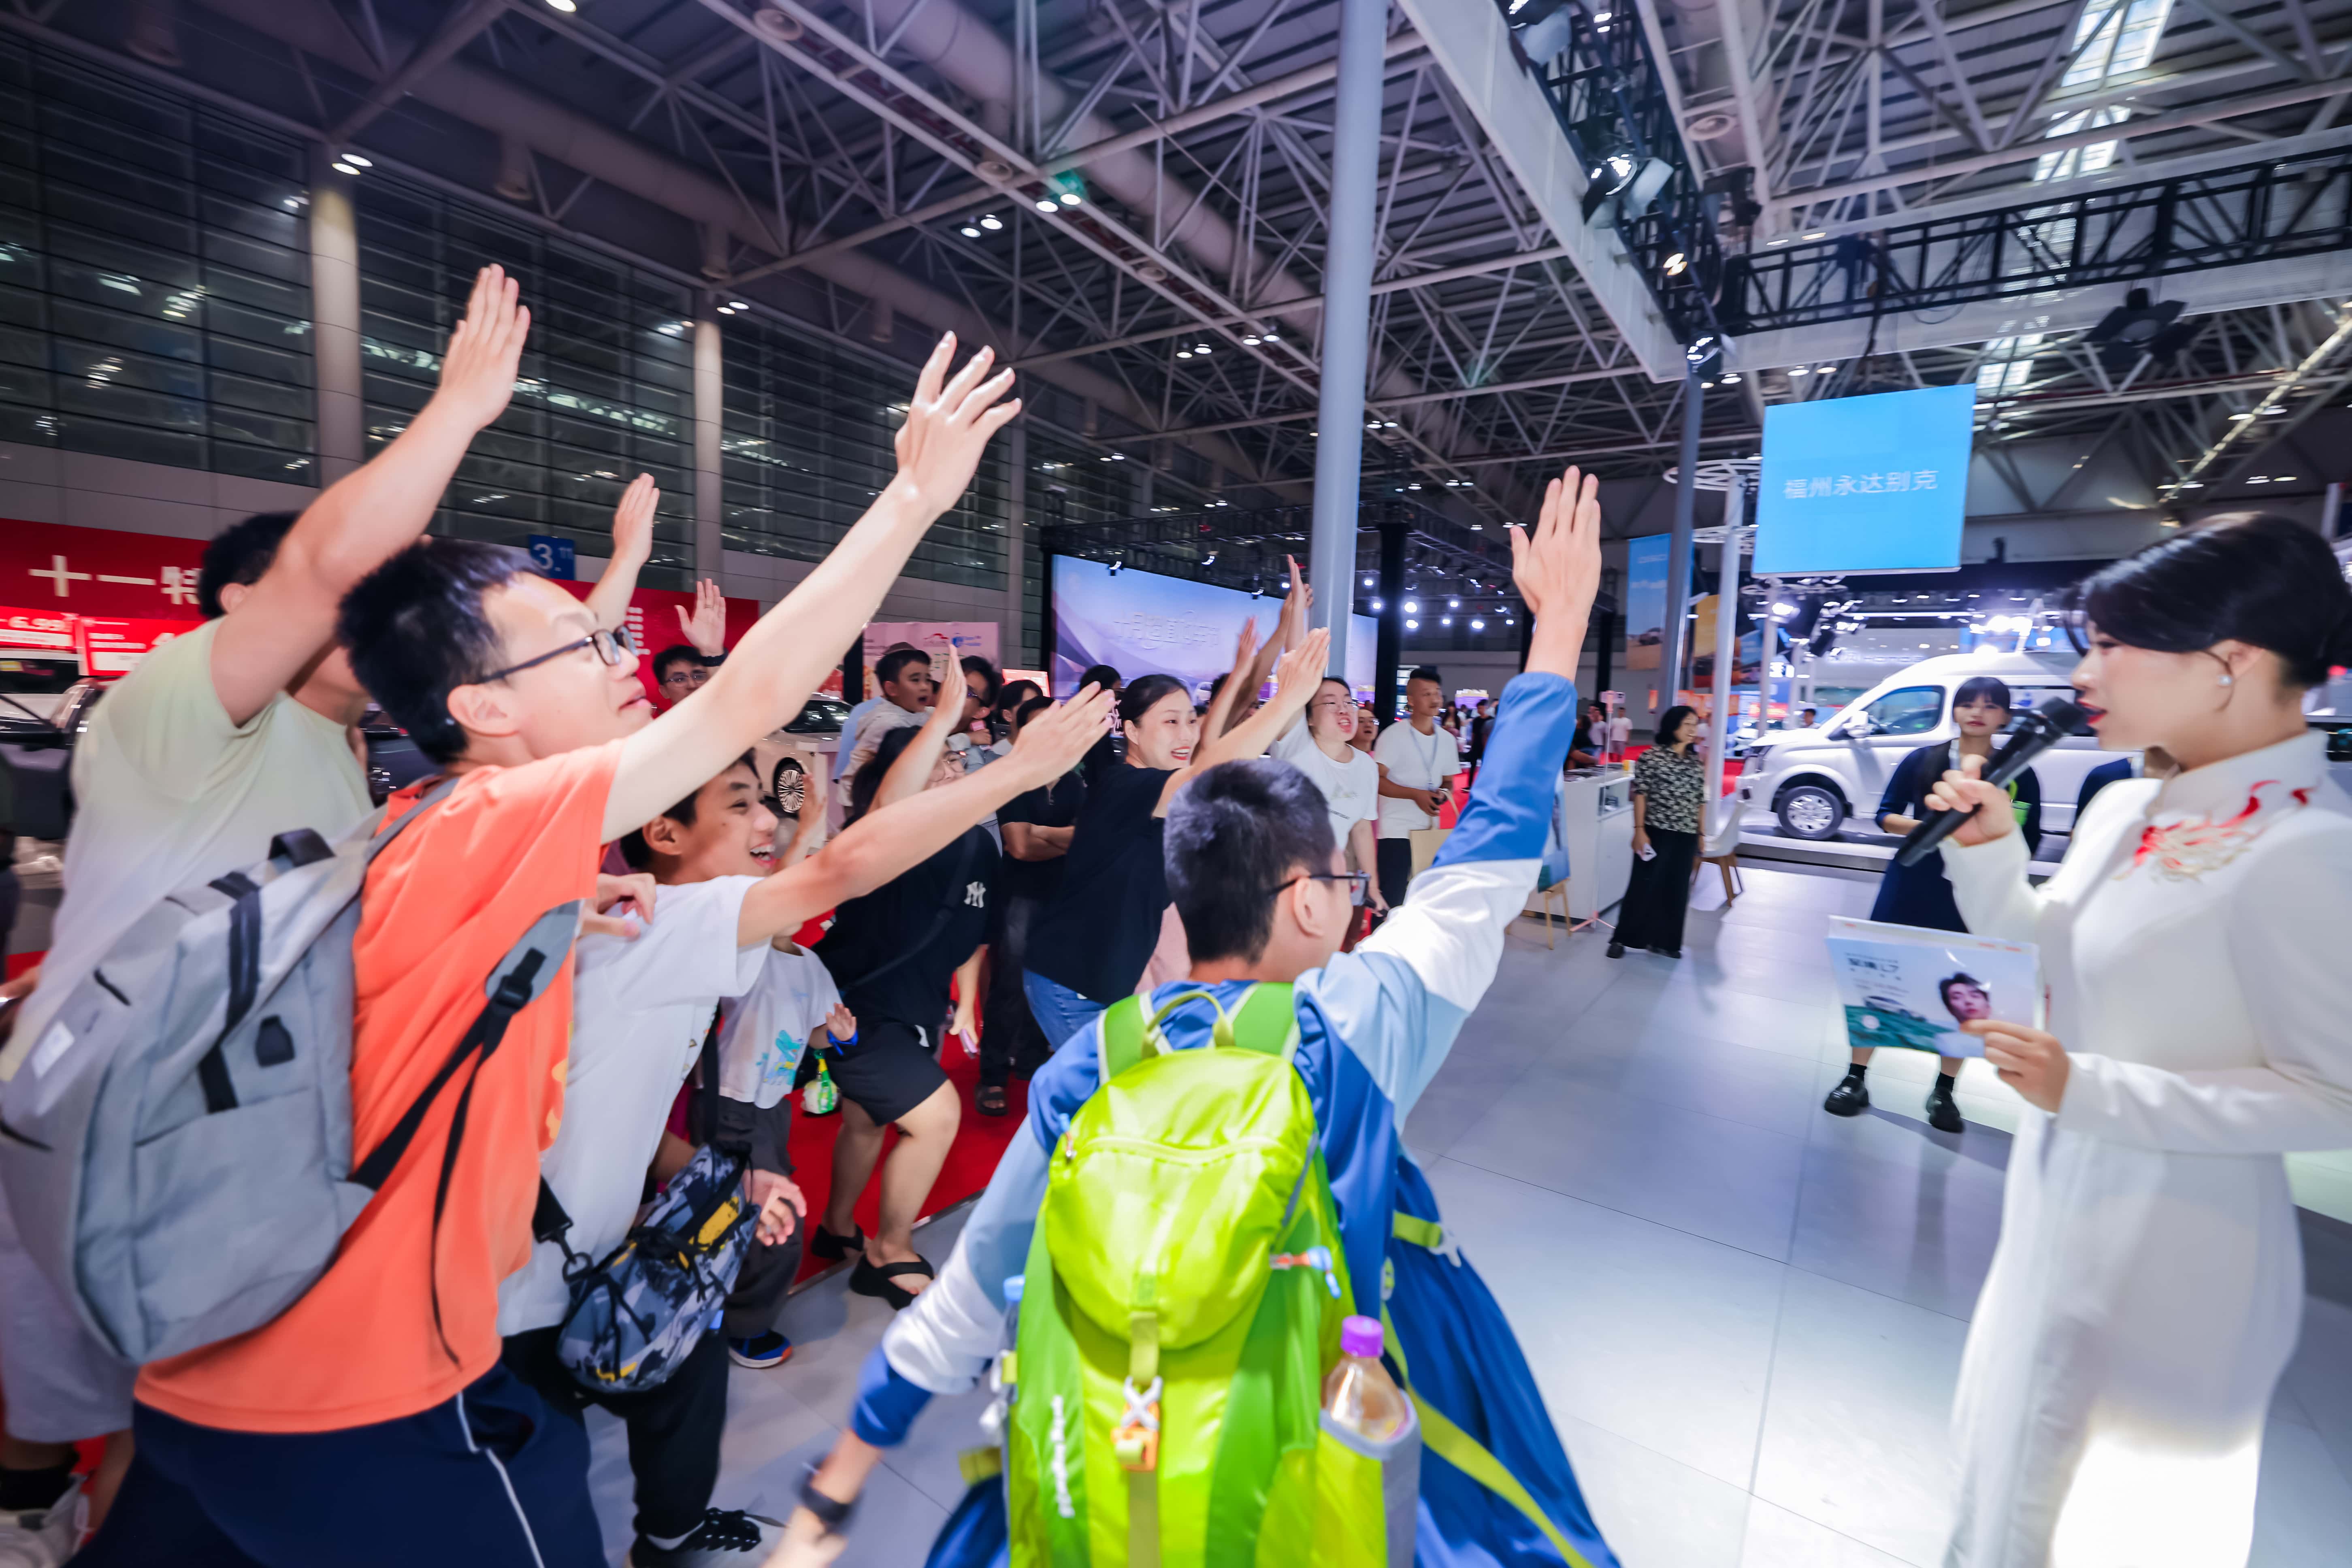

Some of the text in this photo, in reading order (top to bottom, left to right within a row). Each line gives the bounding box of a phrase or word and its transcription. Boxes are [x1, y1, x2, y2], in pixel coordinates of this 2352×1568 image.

[1783, 469, 1939, 499] 福州永达别克
[533, 543, 554, 570] 3
[964, 881, 986, 908] NY
